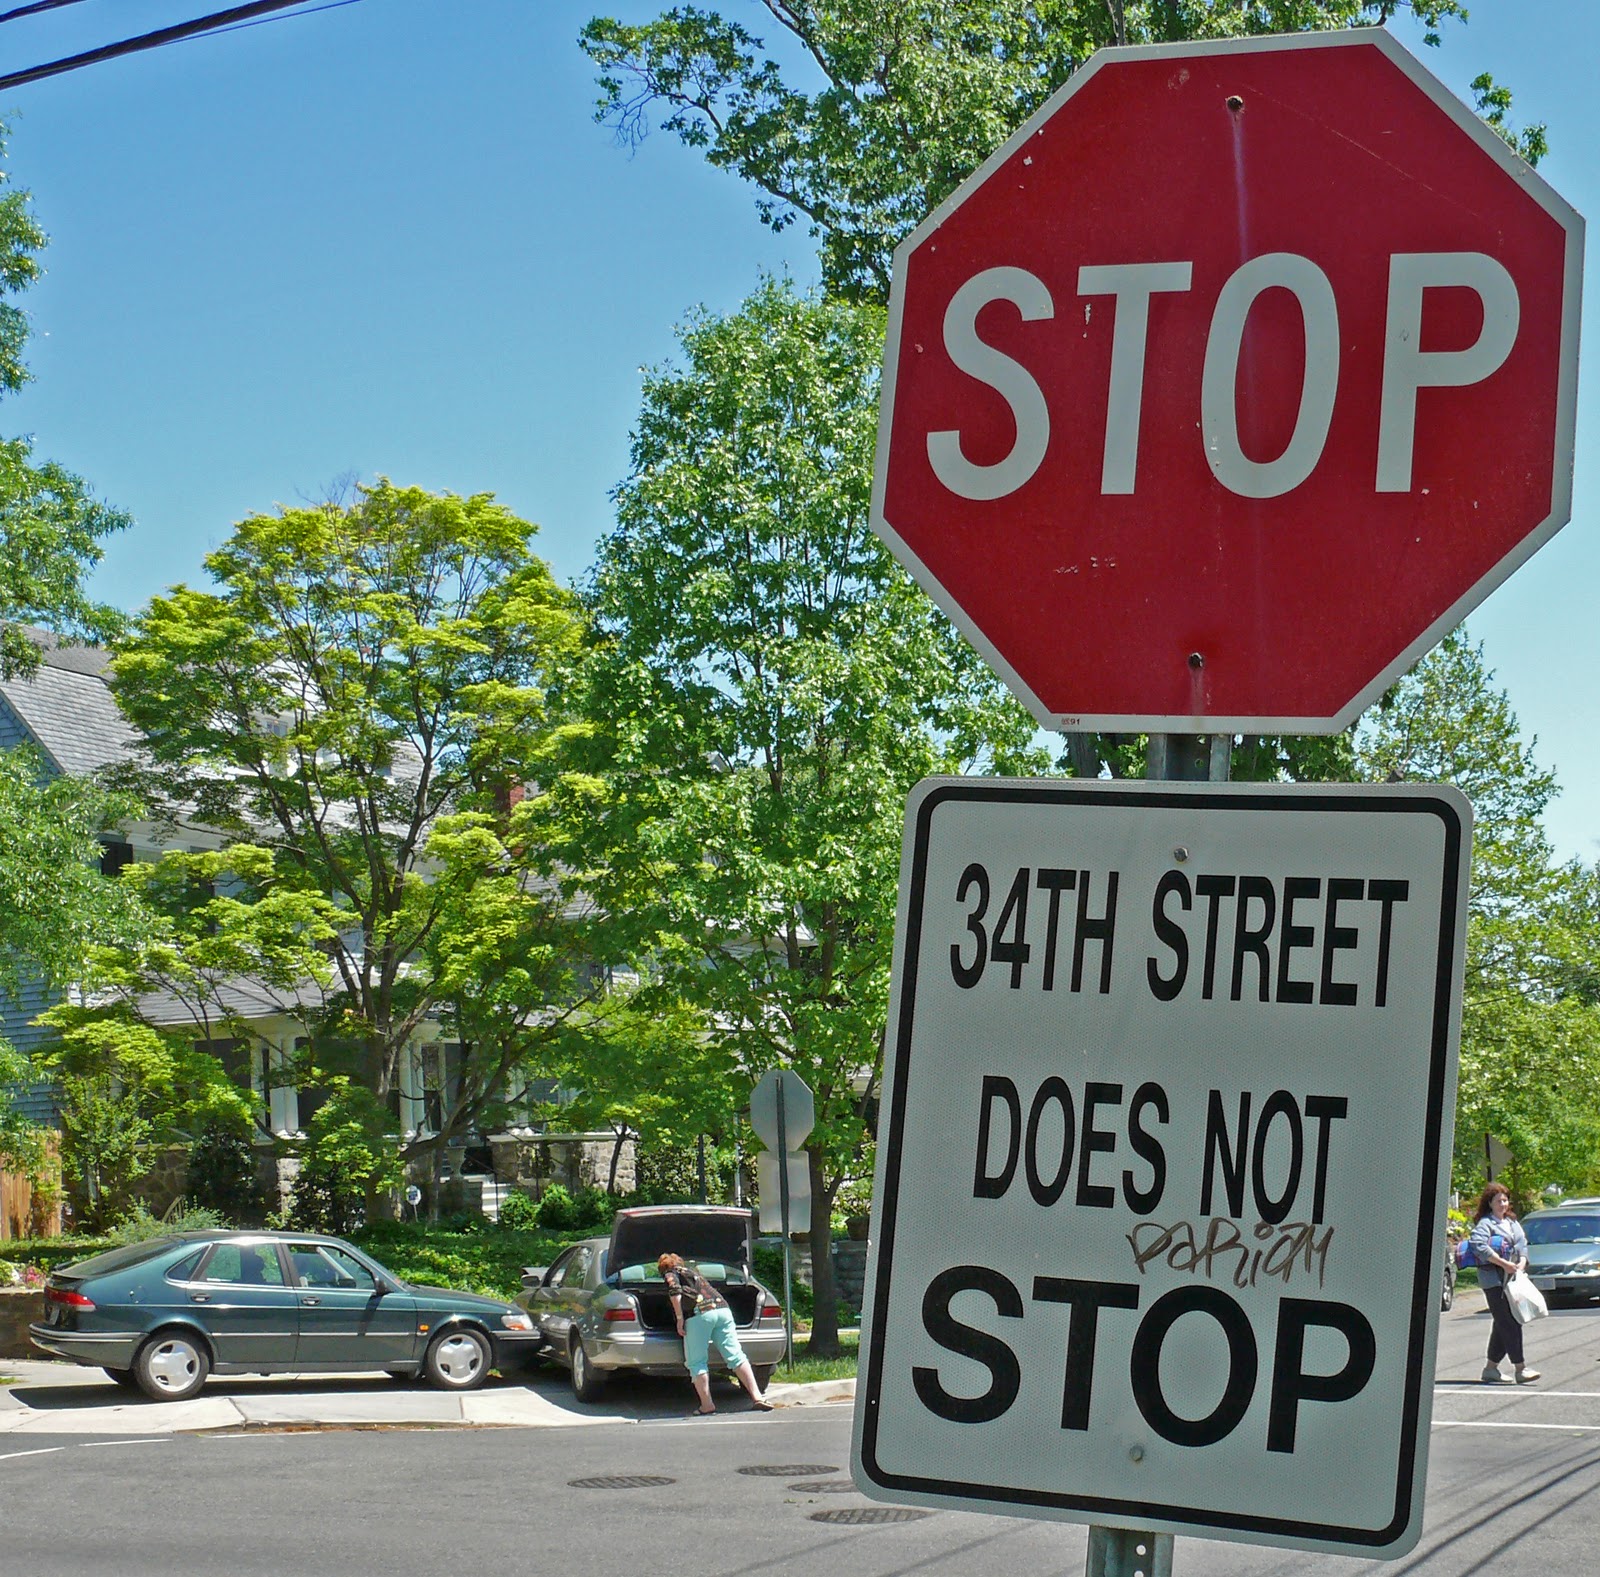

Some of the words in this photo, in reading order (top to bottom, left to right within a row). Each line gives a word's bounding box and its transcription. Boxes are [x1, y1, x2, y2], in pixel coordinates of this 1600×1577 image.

[927, 252, 1520, 500] STOP
[950, 863, 1120, 995] 34TH
[1147, 869, 1409, 1008] STREET
[972, 1075, 1170, 1216] DOES
[1200, 1090, 1348, 1225] NOT
[912, 1265, 1376, 1454] STOP
